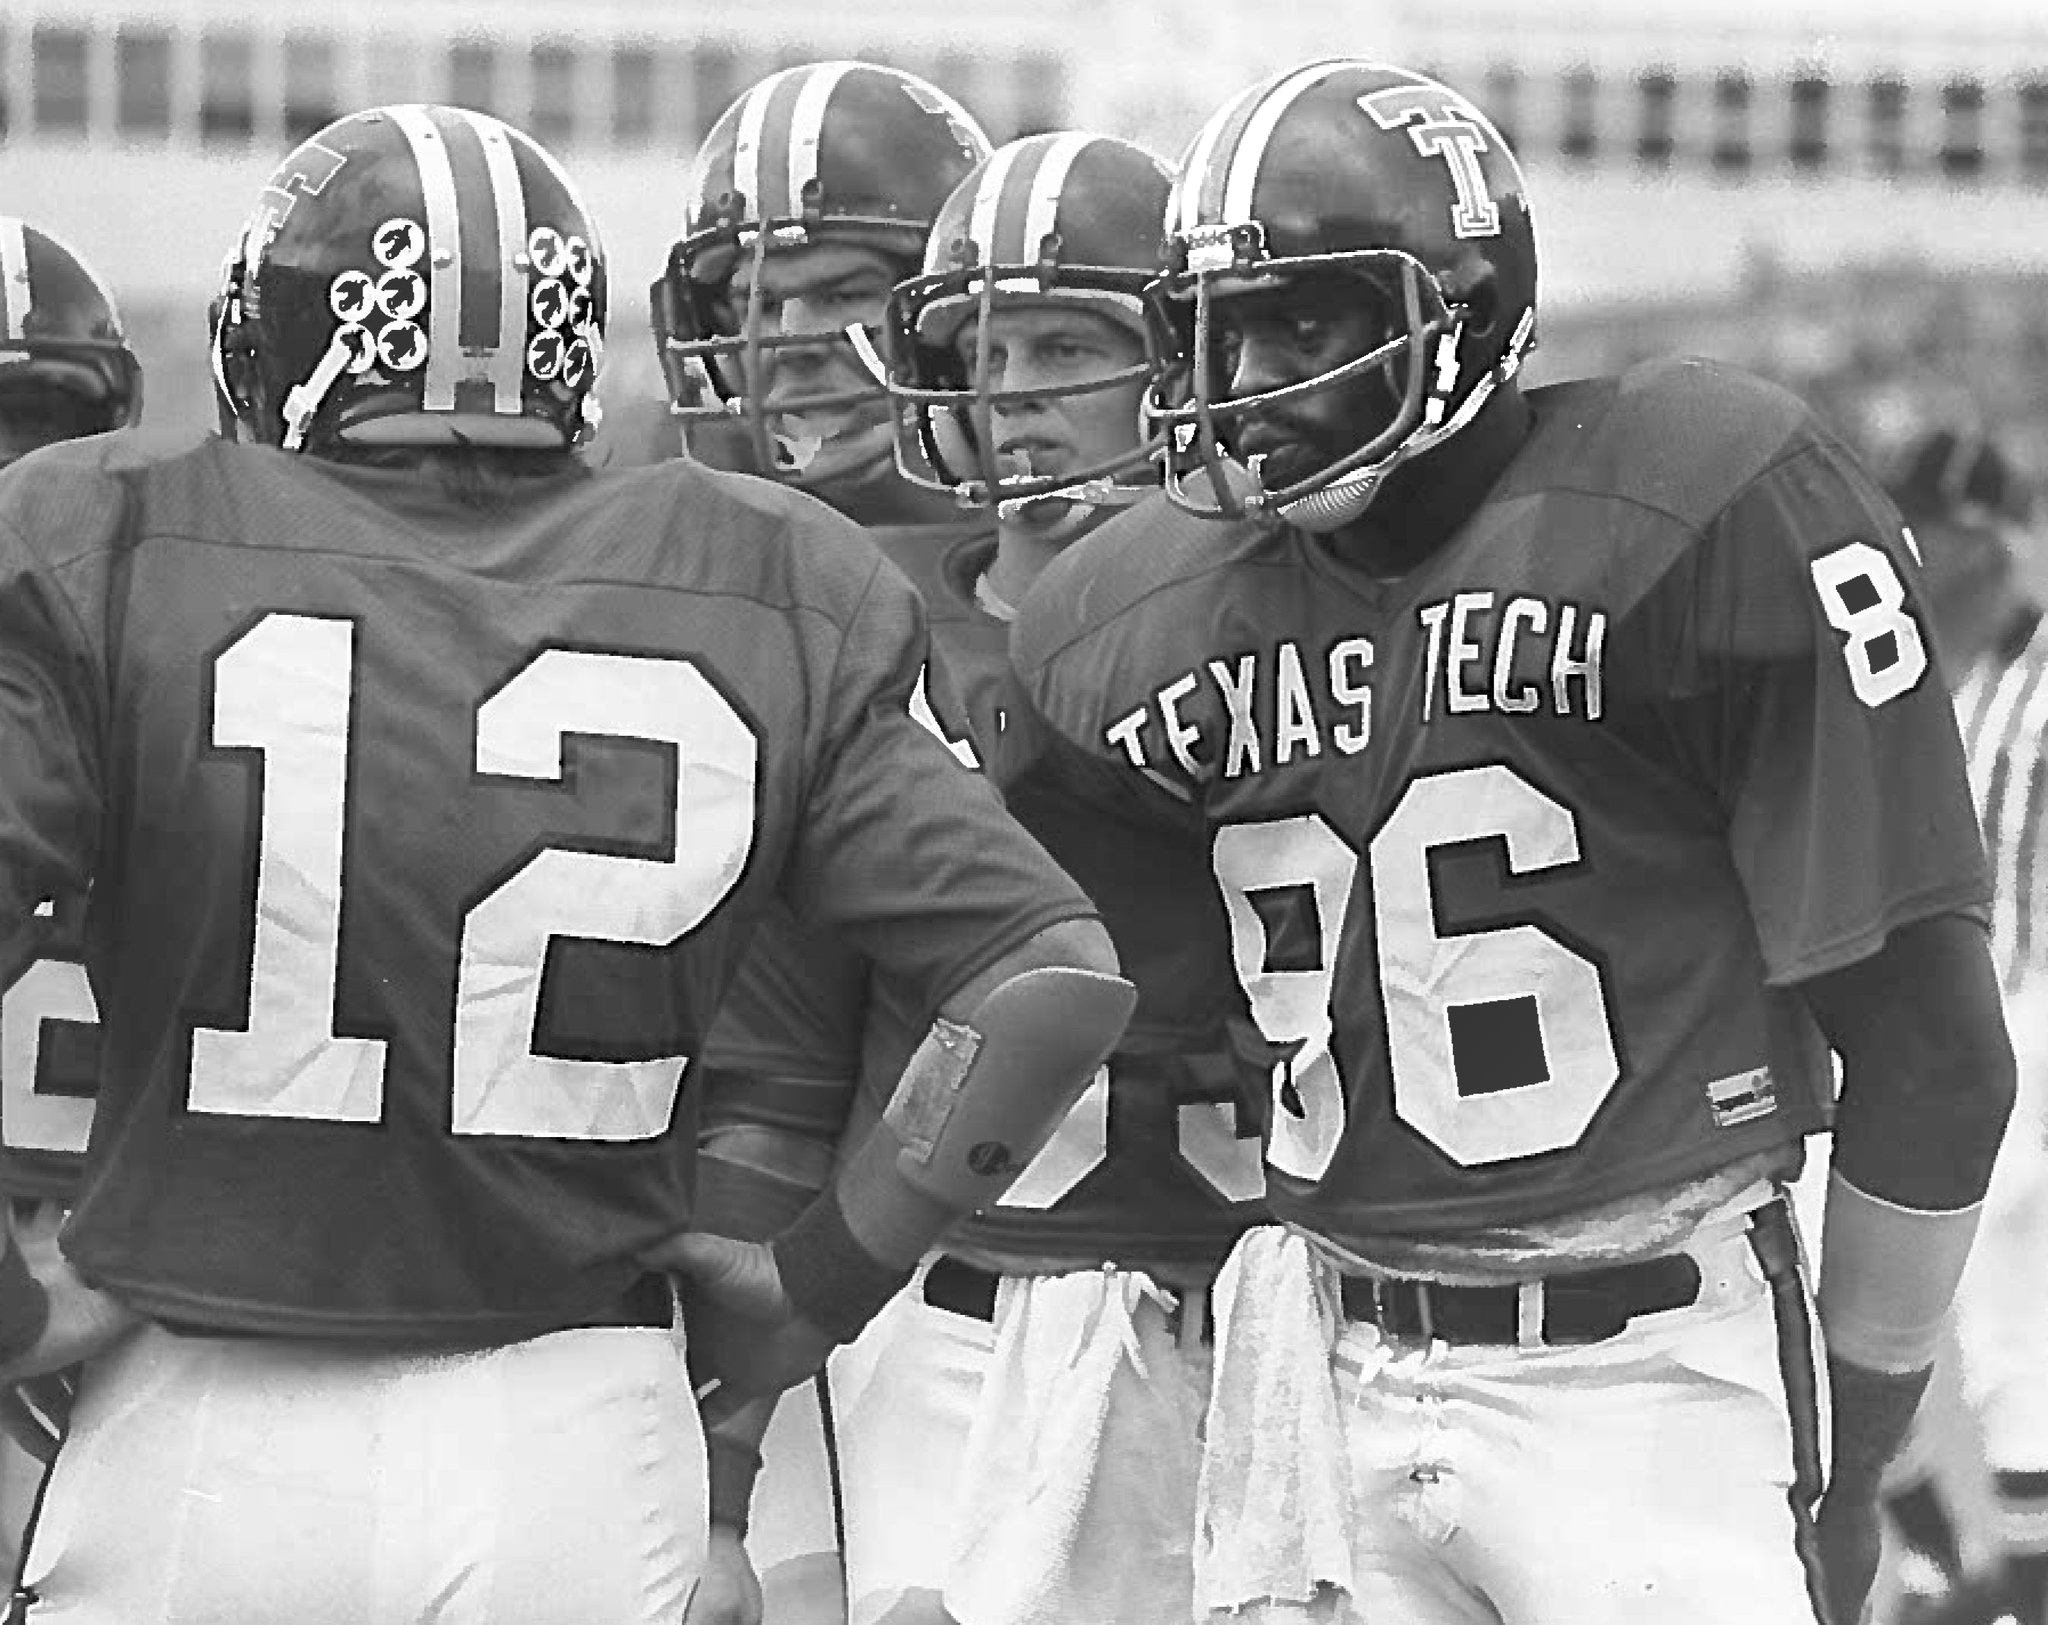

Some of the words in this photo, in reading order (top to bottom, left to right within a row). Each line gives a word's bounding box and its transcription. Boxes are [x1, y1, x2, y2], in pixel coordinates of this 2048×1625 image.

[1105, 637, 1375, 778] TEXAS
[1420, 591, 1606, 723] TECH
[1810, 527, 1928, 709] 8
[186, 611, 758, 1143] 12
